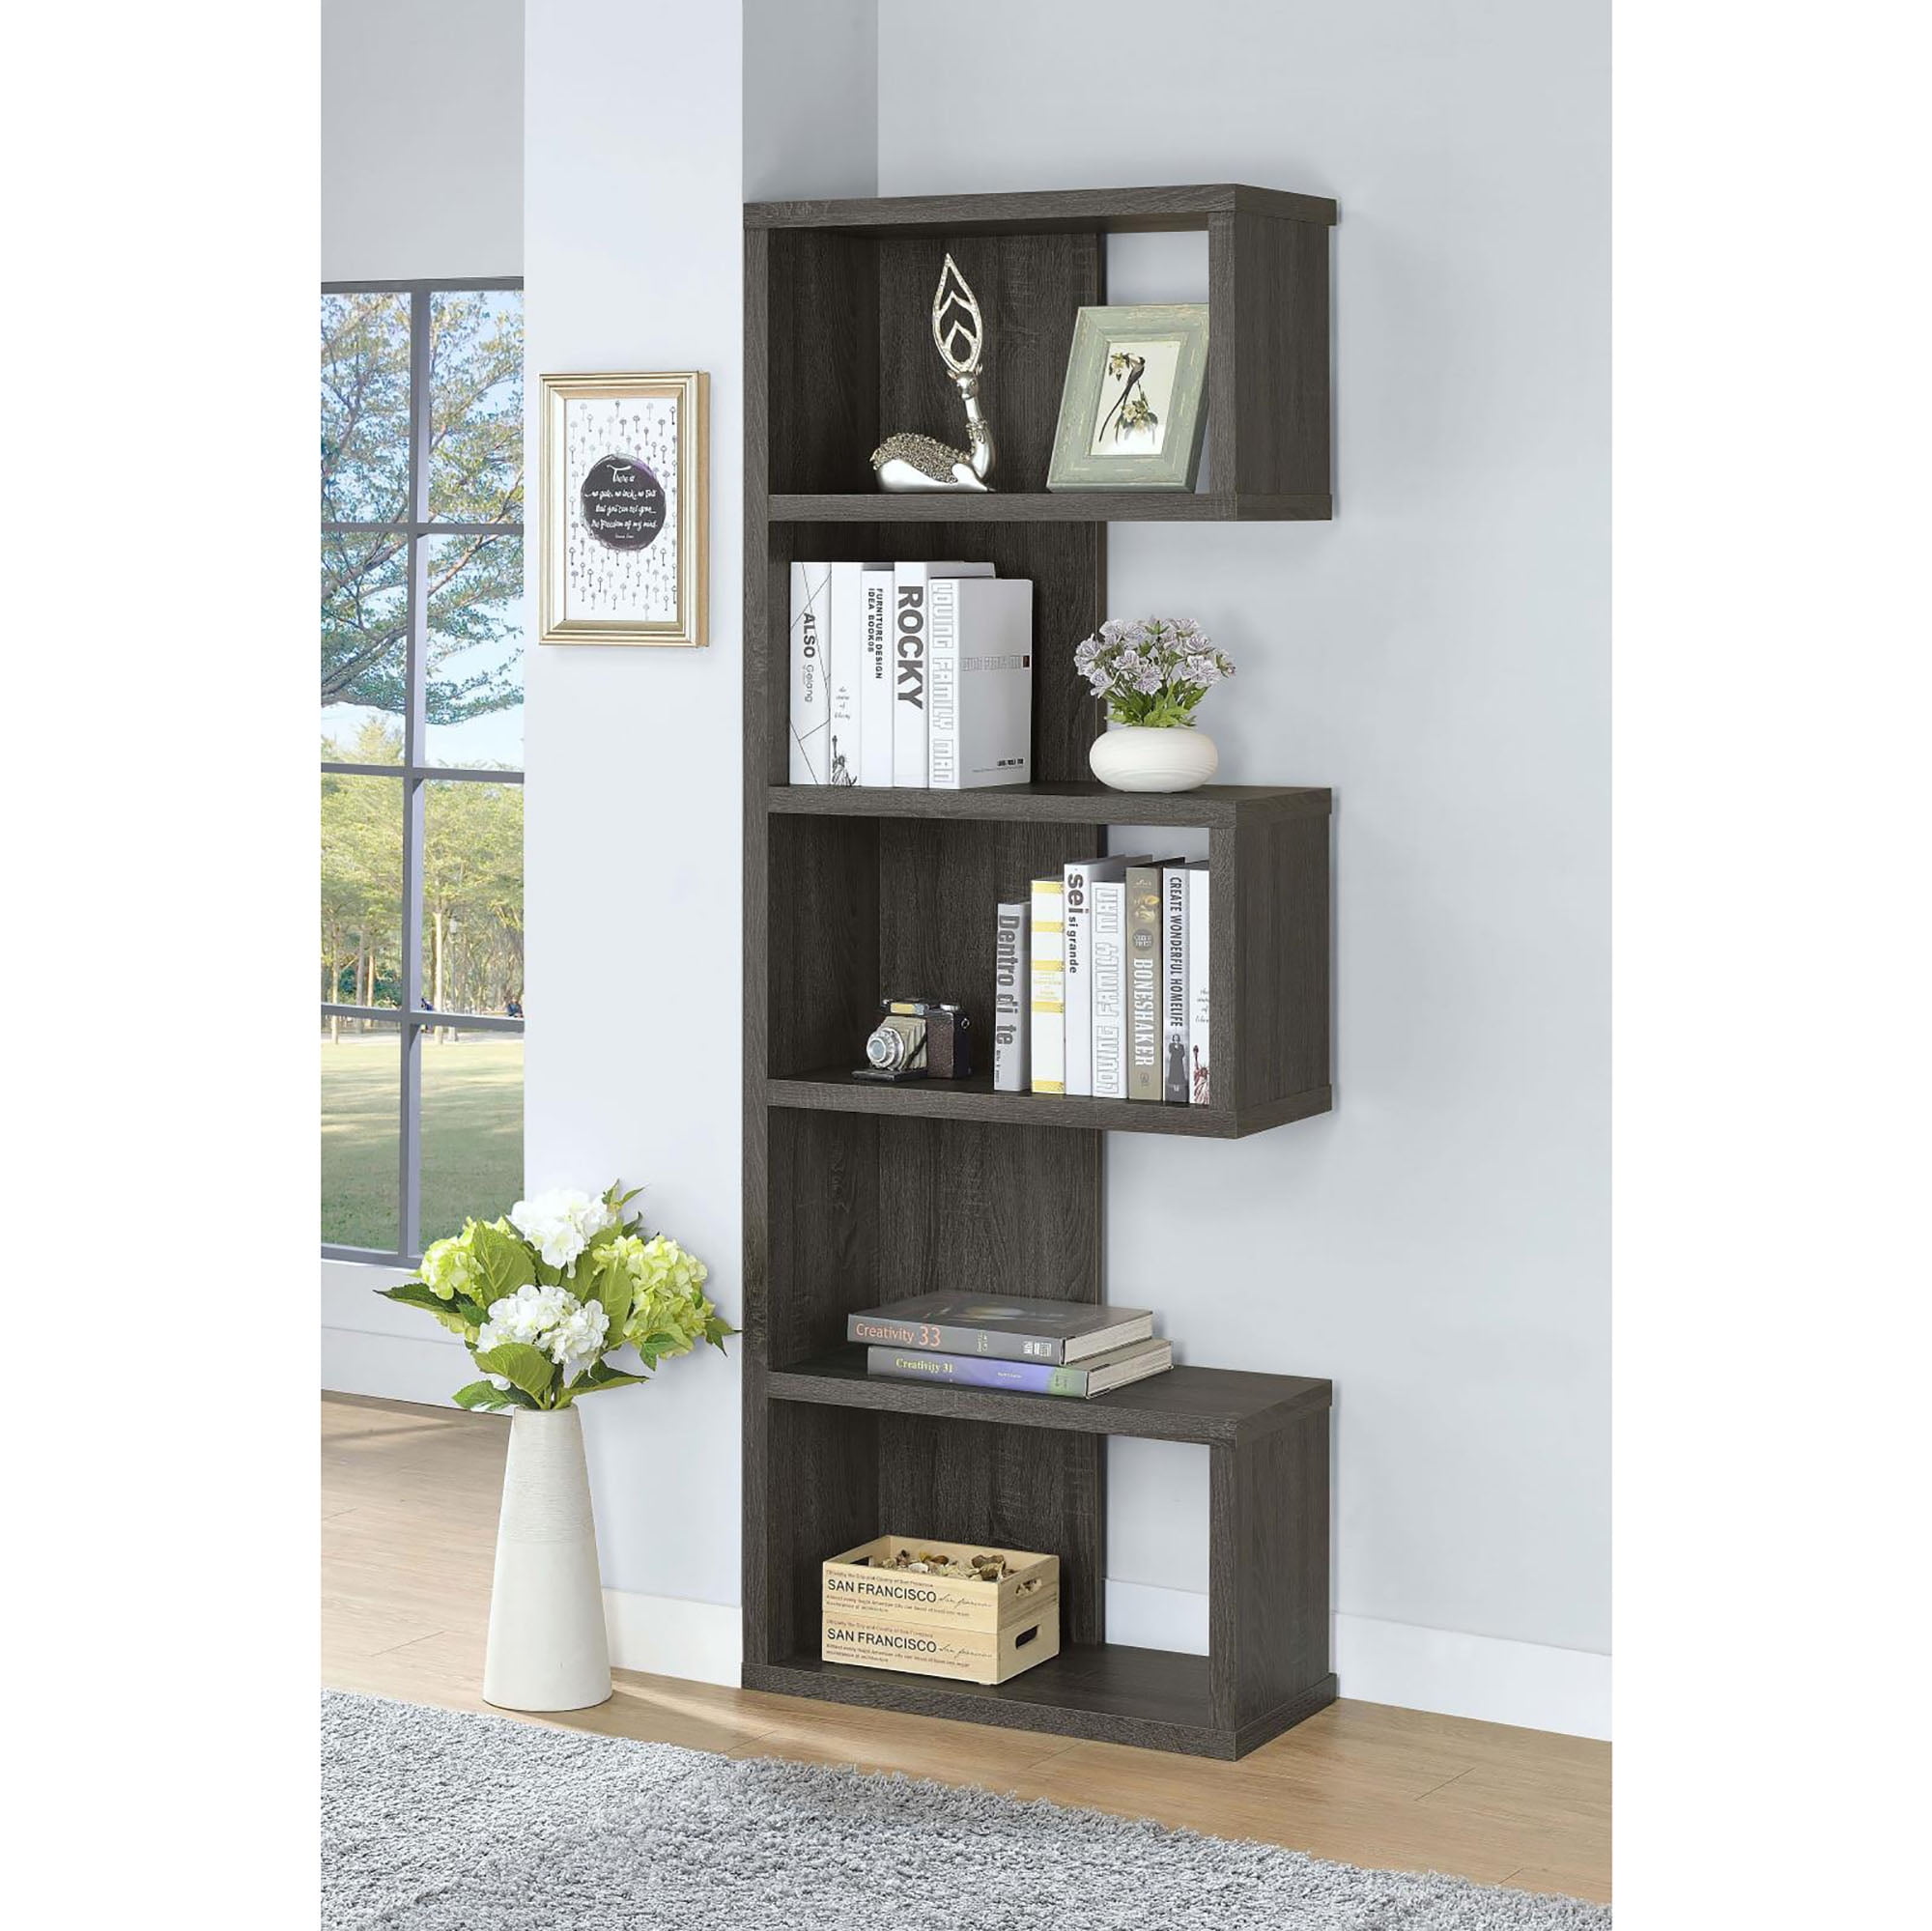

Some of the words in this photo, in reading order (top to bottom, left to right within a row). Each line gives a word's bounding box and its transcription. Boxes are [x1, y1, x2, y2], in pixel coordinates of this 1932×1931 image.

[803, 612, 816, 658] ALSO
[875, 588, 884, 641] FURNITURE
[897, 585, 924, 710] ROCKY
[932, 657, 954, 730] FAMILY
[932, 739, 954, 783] MAN
[1067, 873, 1090, 915] sei
[1094, 887, 1119, 934] MAN
[1170, 876, 1182, 912] CREATE
[1068, 917, 1079, 928] si
[997, 914, 1020, 987] Dentro
[1065, 930, 1079, 975] grande
[1170, 915, 1182, 977] WONDERFUL
[1094, 941, 1121, 1017] FAMILY
[996, 995, 1019, 1014] di
[1133, 957, 1155, 1066] BONESHAKER
[1170, 979, 1183, 1028] HOMELIFE
[996, 1024, 1016, 1045] te
[856, 1323, 915, 1344] Creativity
[919, 1325, 942, 1348] 33
[942, 1362, 953, 1374] 31
[827, 1578, 854, 1593] SAN
[858, 1582, 937, 1604] FRANCISCO
[827, 1628, 854, 1642] SAN
[858, 1632, 937, 1653] FRANCISCO
